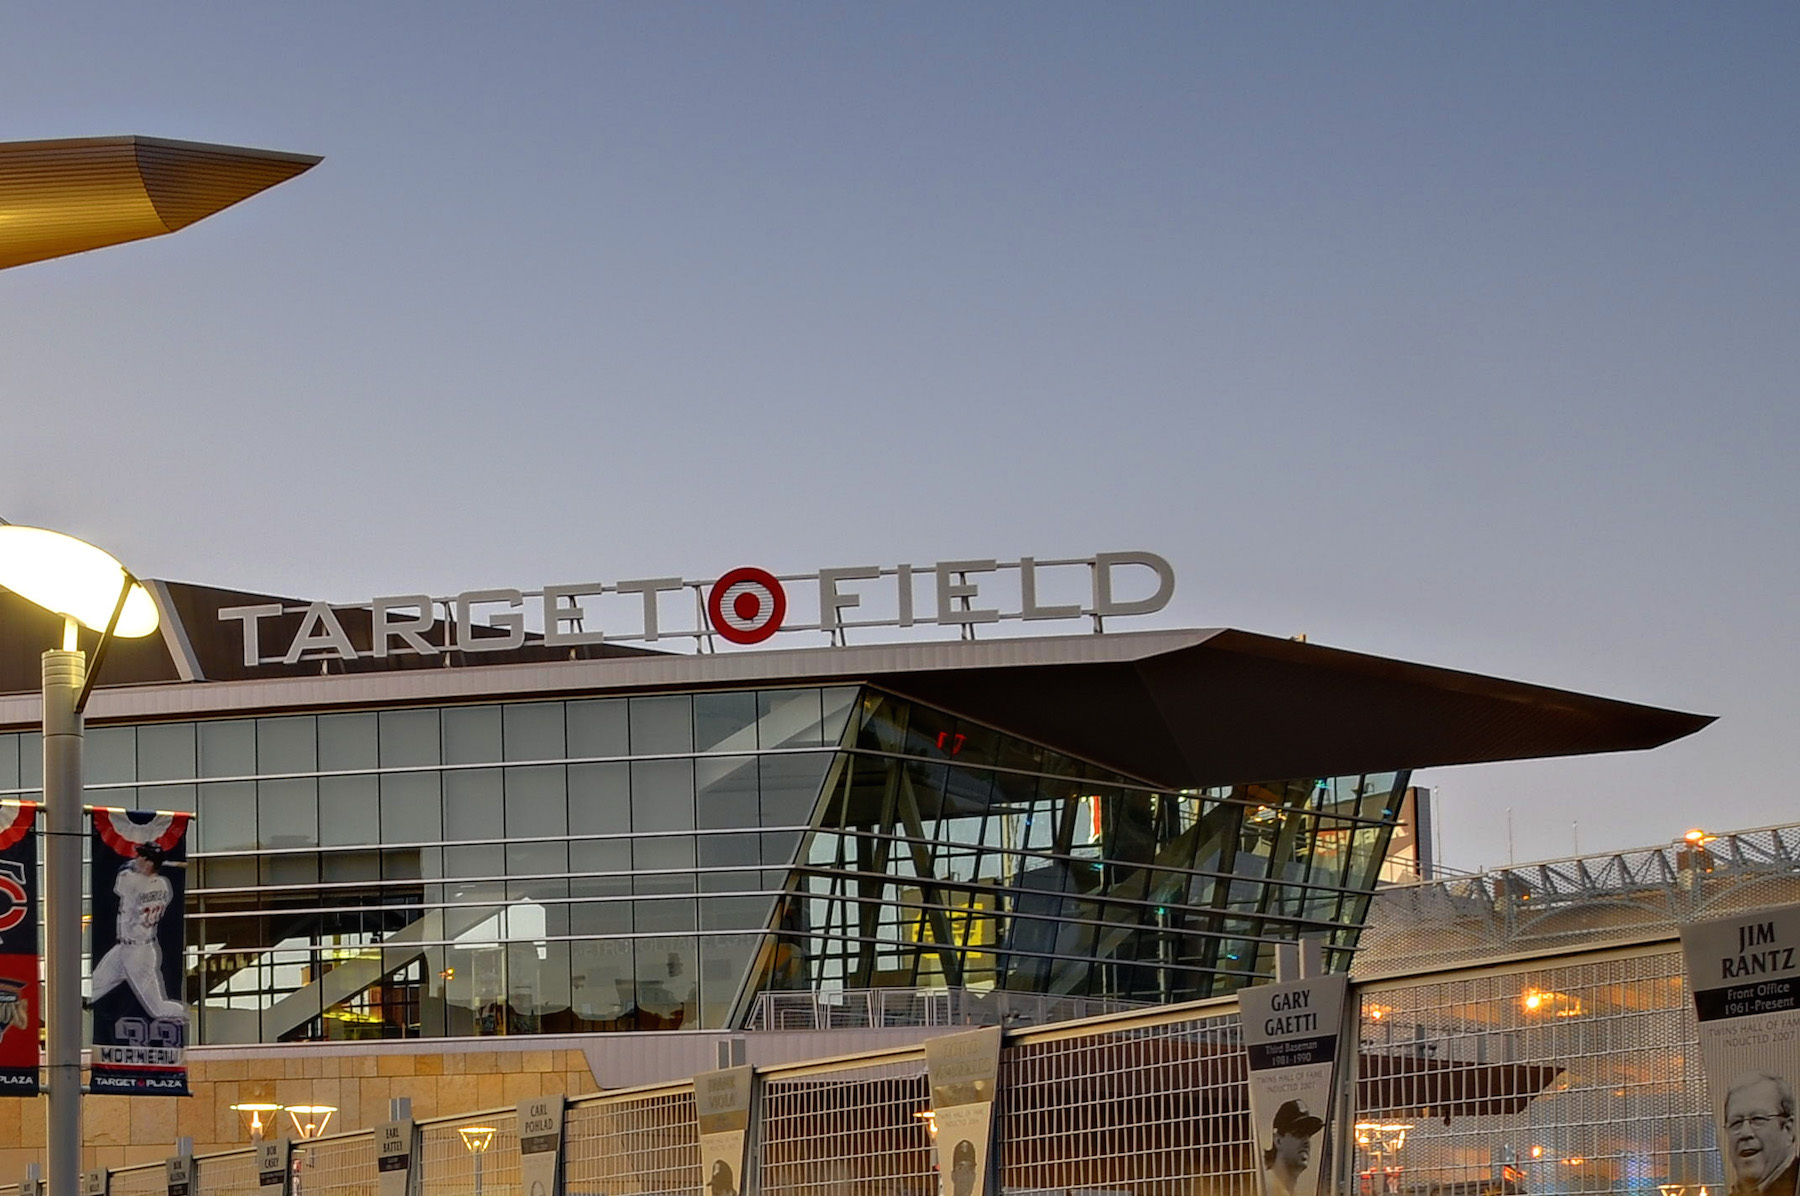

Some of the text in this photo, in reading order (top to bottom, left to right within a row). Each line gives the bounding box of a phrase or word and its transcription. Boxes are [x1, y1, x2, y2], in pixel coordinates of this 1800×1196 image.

[218, 550, 1176, 667] TARGET FIELD
[1739, 921, 1776, 953] JIM
[1721, 947, 1796, 979] RANTZ
[1271, 989, 1311, 1012] GARY
[1727, 983, 1790, 1001] Front Office
[1725, 997, 1795, 1016] 1961-Present
[1264, 1012, 1318, 1037] GAETTI
[1707, 1016, 1800, 1037] TWINS HALL OF FAM
[1772, 1030, 1796, 1043] 2007
[101, 1047, 176, 1064] MORNEAU
[1265, 1041, 1318, 1055] Third Baseman
[1272, 1052, 1312, 1066] 1981-1990
[95, 1077, 183, 1088] TARGET PLAZA
[530, 1104, 548, 1118] CARL
[525, 1118, 554, 1134] POHLAD
